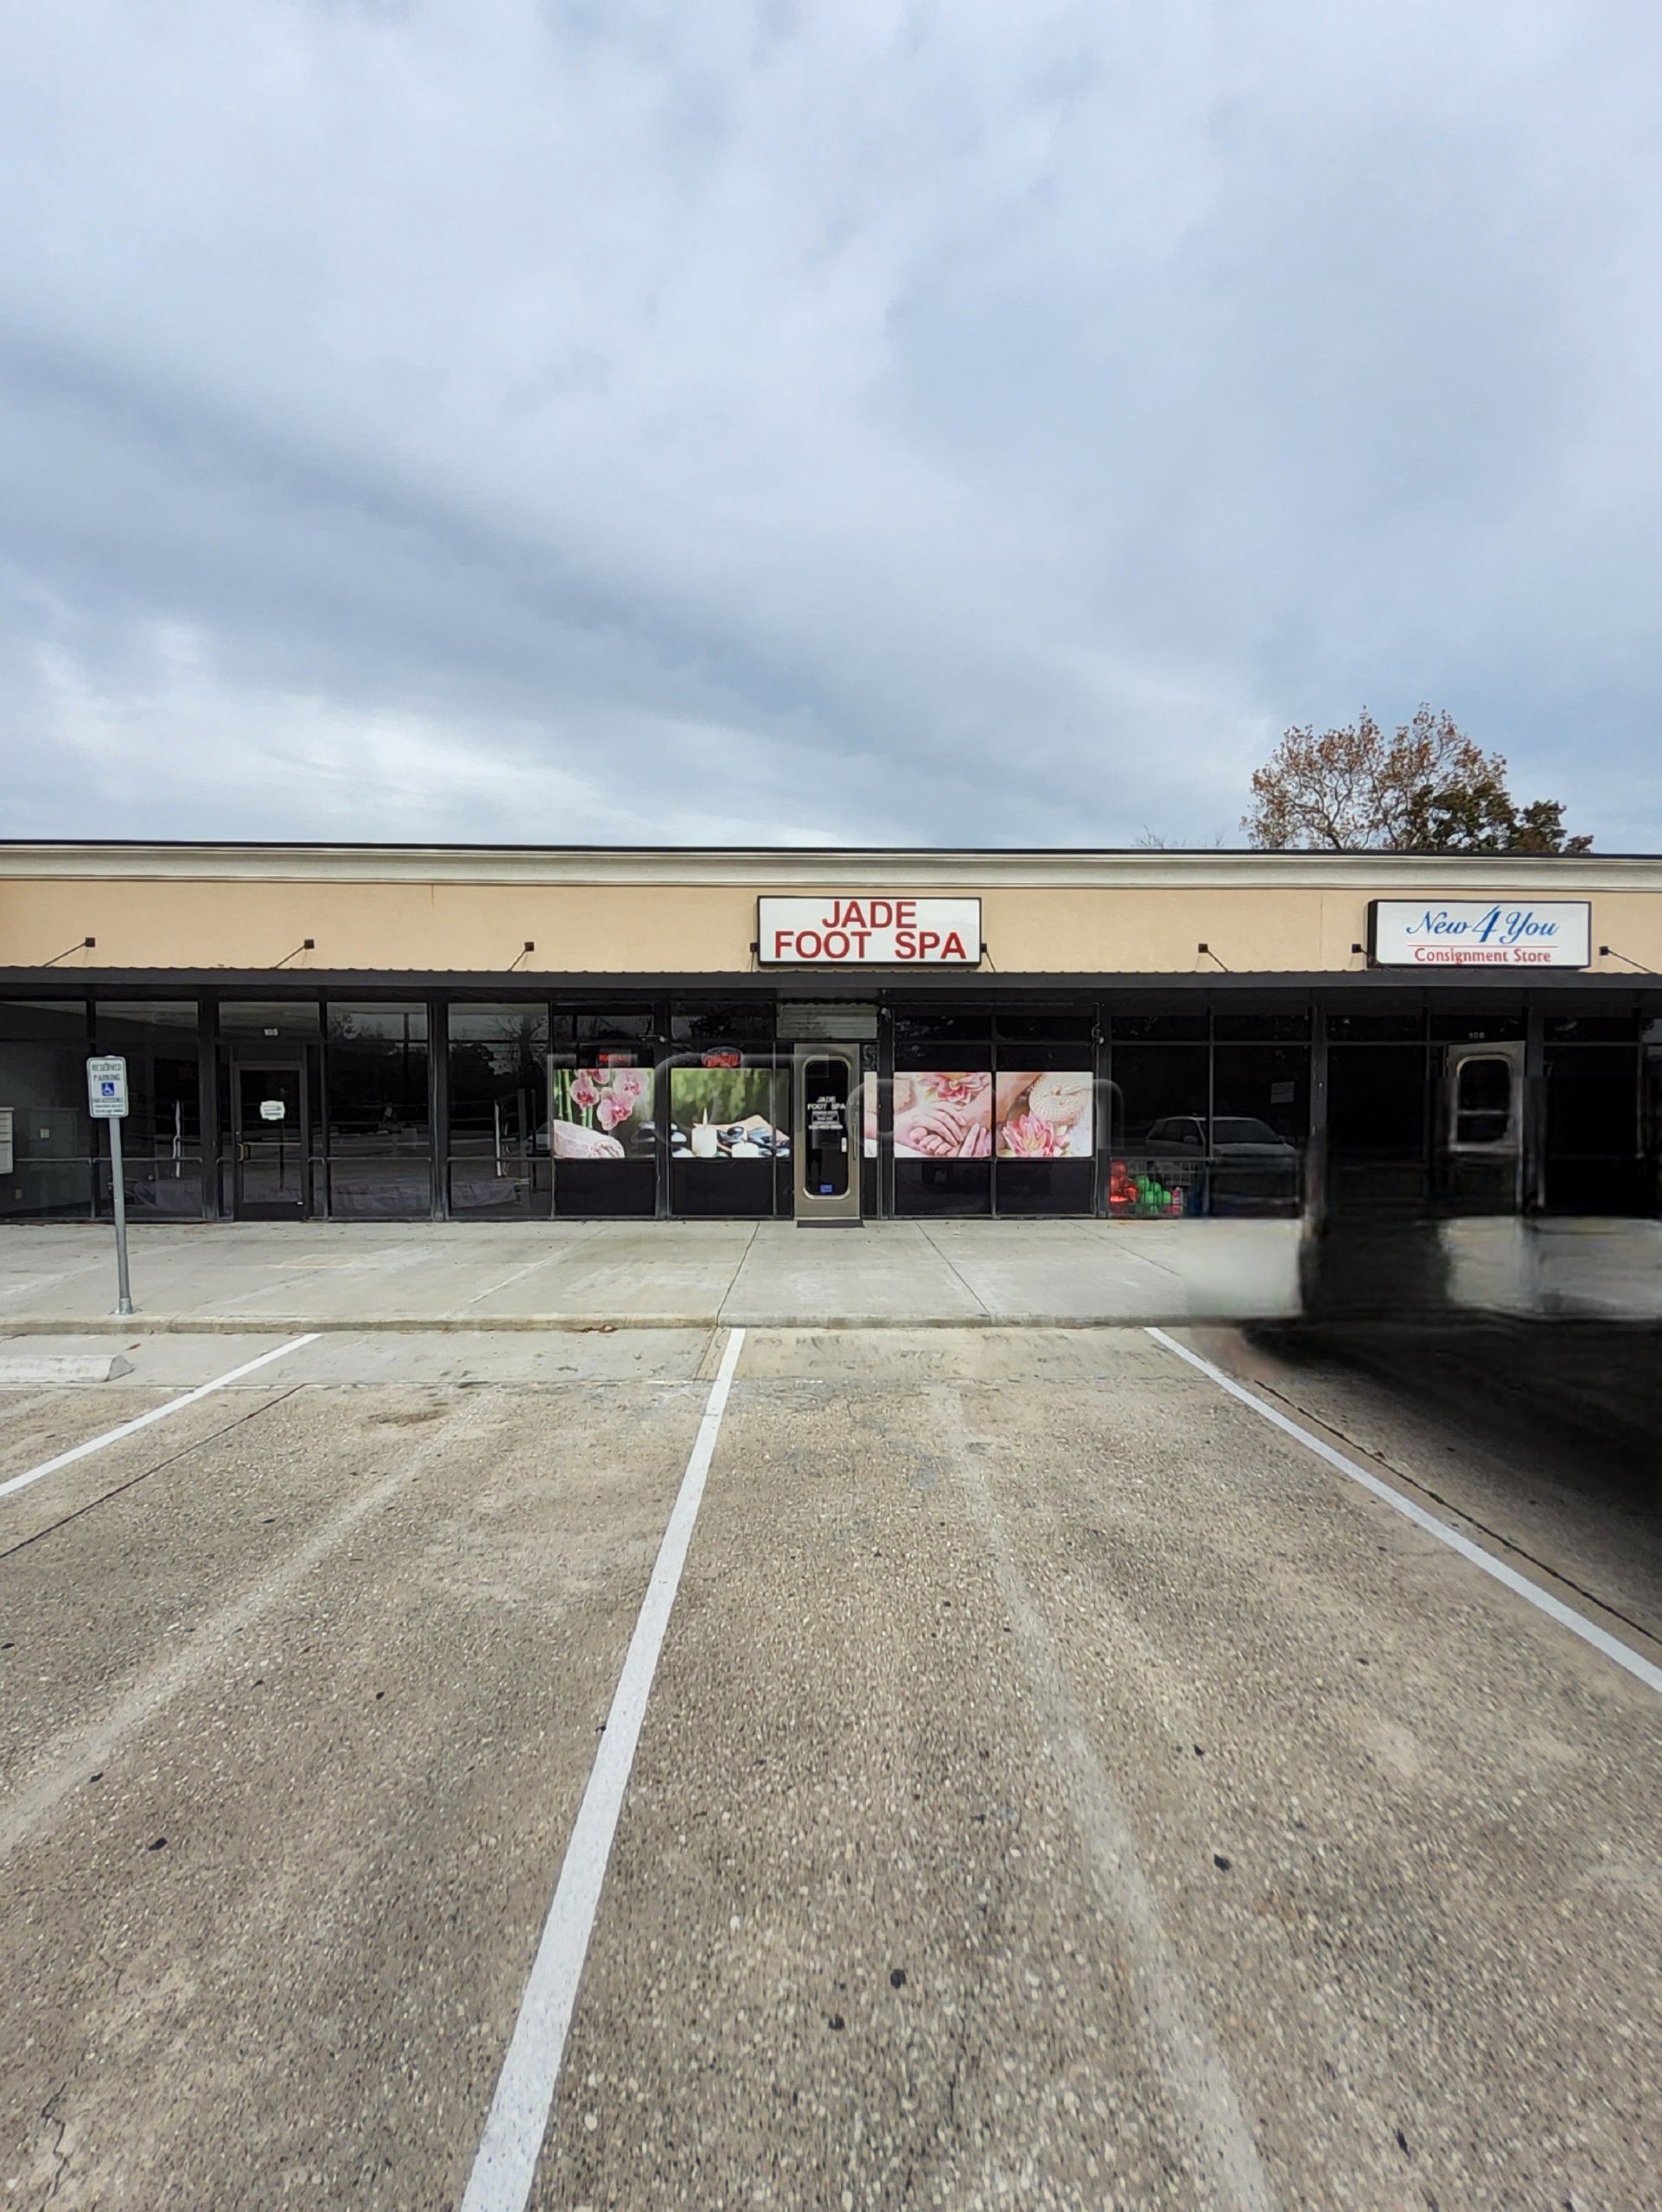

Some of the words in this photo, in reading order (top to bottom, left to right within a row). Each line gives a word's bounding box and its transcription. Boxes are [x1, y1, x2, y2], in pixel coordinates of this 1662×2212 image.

[822, 900, 918, 929] JADE
[1405, 910, 1472, 935] New
[1471, 905, 1502, 944] 4
[1499, 911, 1560, 944] You
[774, 931, 872, 959] FOOT
[894, 931, 967, 960] SPA
[1414, 947, 1508, 967] Consignment
[1512, 948, 1552, 963] Store
